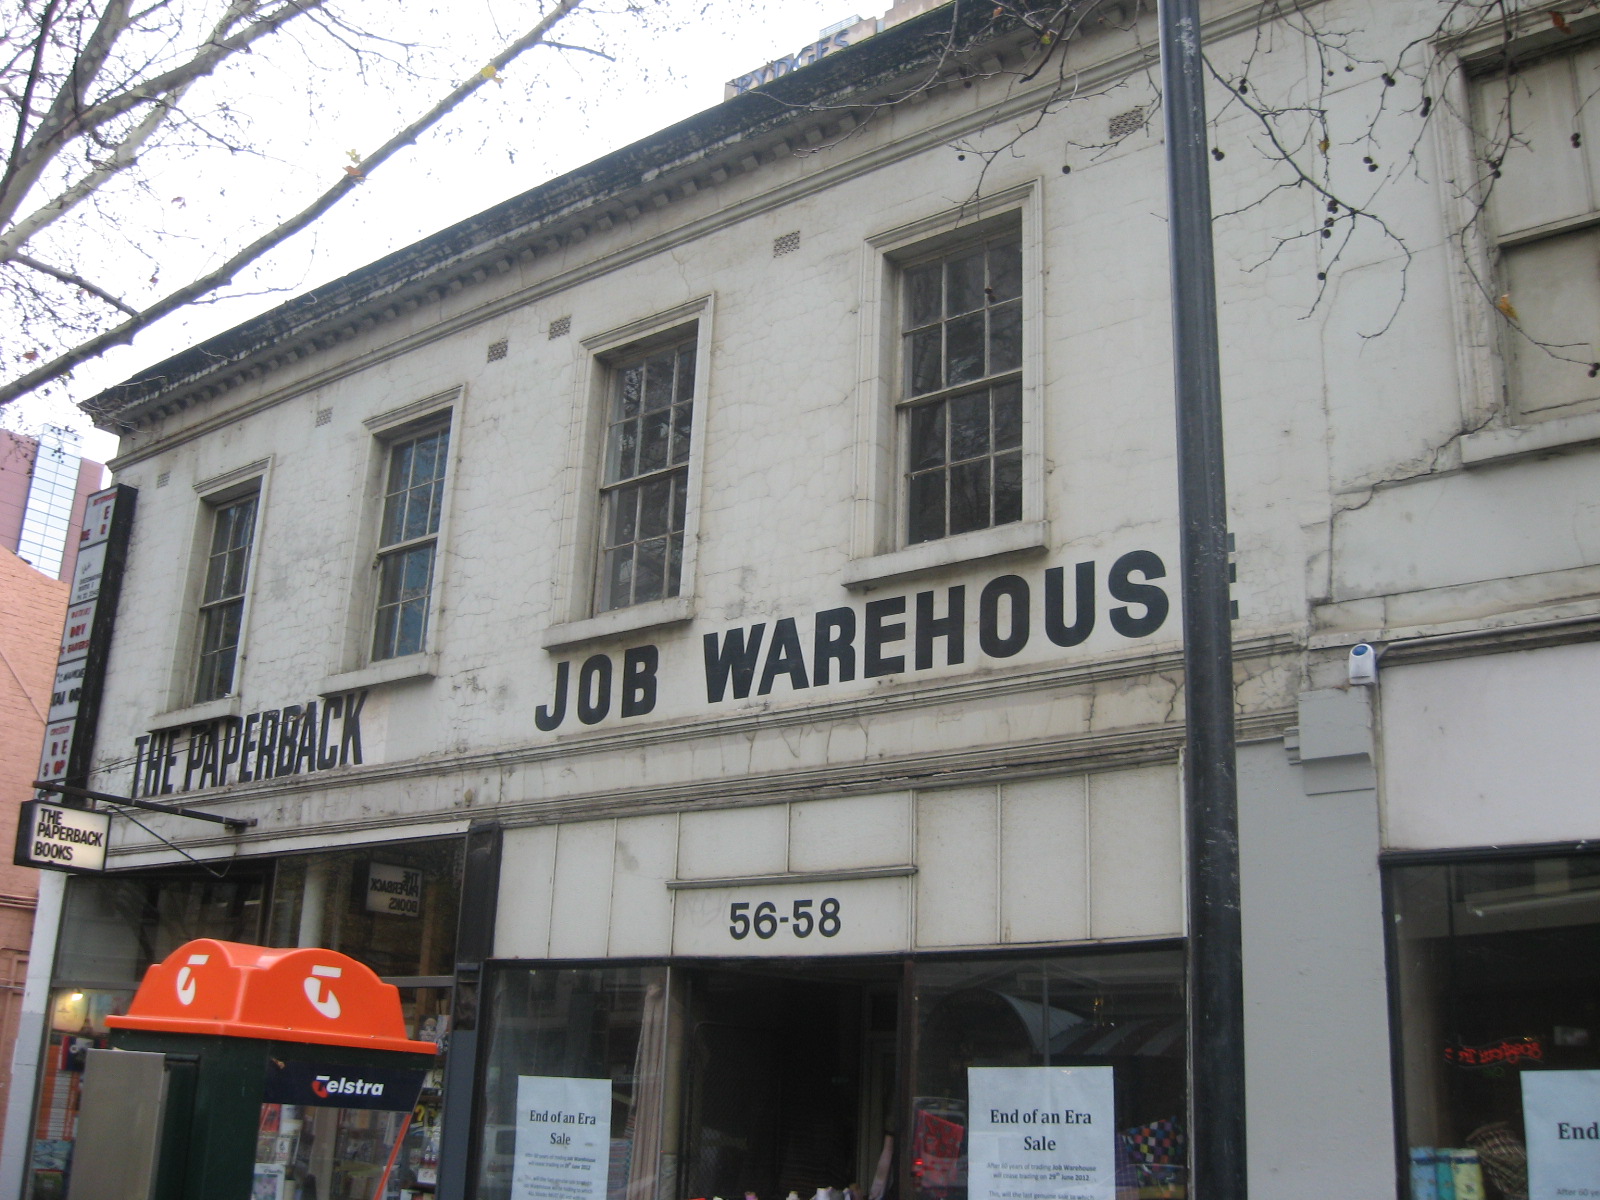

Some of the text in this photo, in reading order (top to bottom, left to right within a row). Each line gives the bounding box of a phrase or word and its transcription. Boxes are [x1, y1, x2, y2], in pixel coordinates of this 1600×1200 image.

[535, 532, 1239, 732] JOB WAREHOUS
[131, 691, 367, 799] THE PAPERBACK
[41, 808, 63, 826] THE
[37, 822, 104, 847] PAPERBACK
[34, 841, 74, 861] BOOKS
[729, 897, 841, 941] 56-58
[311, 1075, 385, 1098] Telstra
[530, 1109, 596, 1125] End of an Era
[990, 1109, 1092, 1124] End of an Era
[550, 1132, 571, 1146] Sale
[1557, 1121, 1600, 1140] End
[1024, 1135, 1056, 1151] Sale
